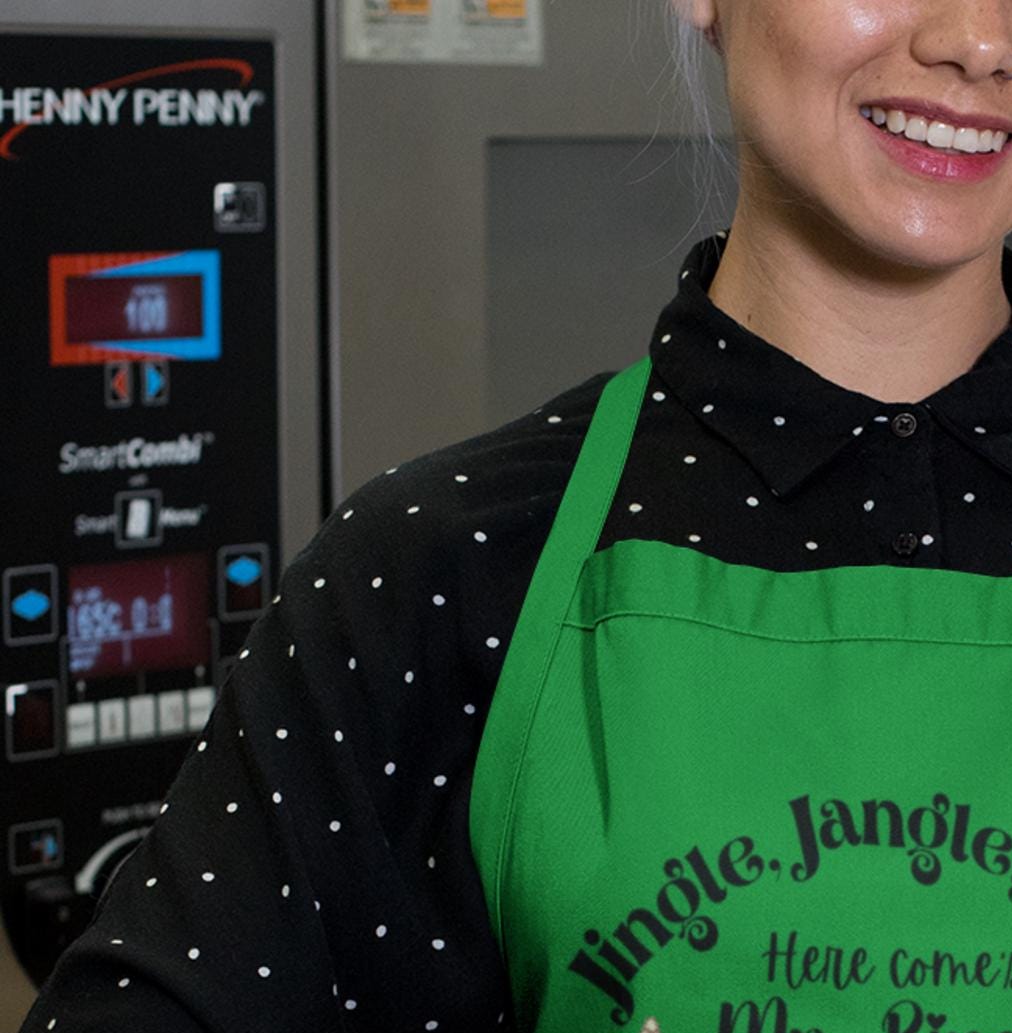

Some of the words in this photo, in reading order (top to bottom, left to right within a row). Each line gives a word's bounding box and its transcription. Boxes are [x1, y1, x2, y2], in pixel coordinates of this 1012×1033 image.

[0, 87, 127, 126] HENNY
[59, 436, 203, 473] SmartCombi
[567, 834, 782, 1027] Jingle,
[761, 931, 876, 990] Here
